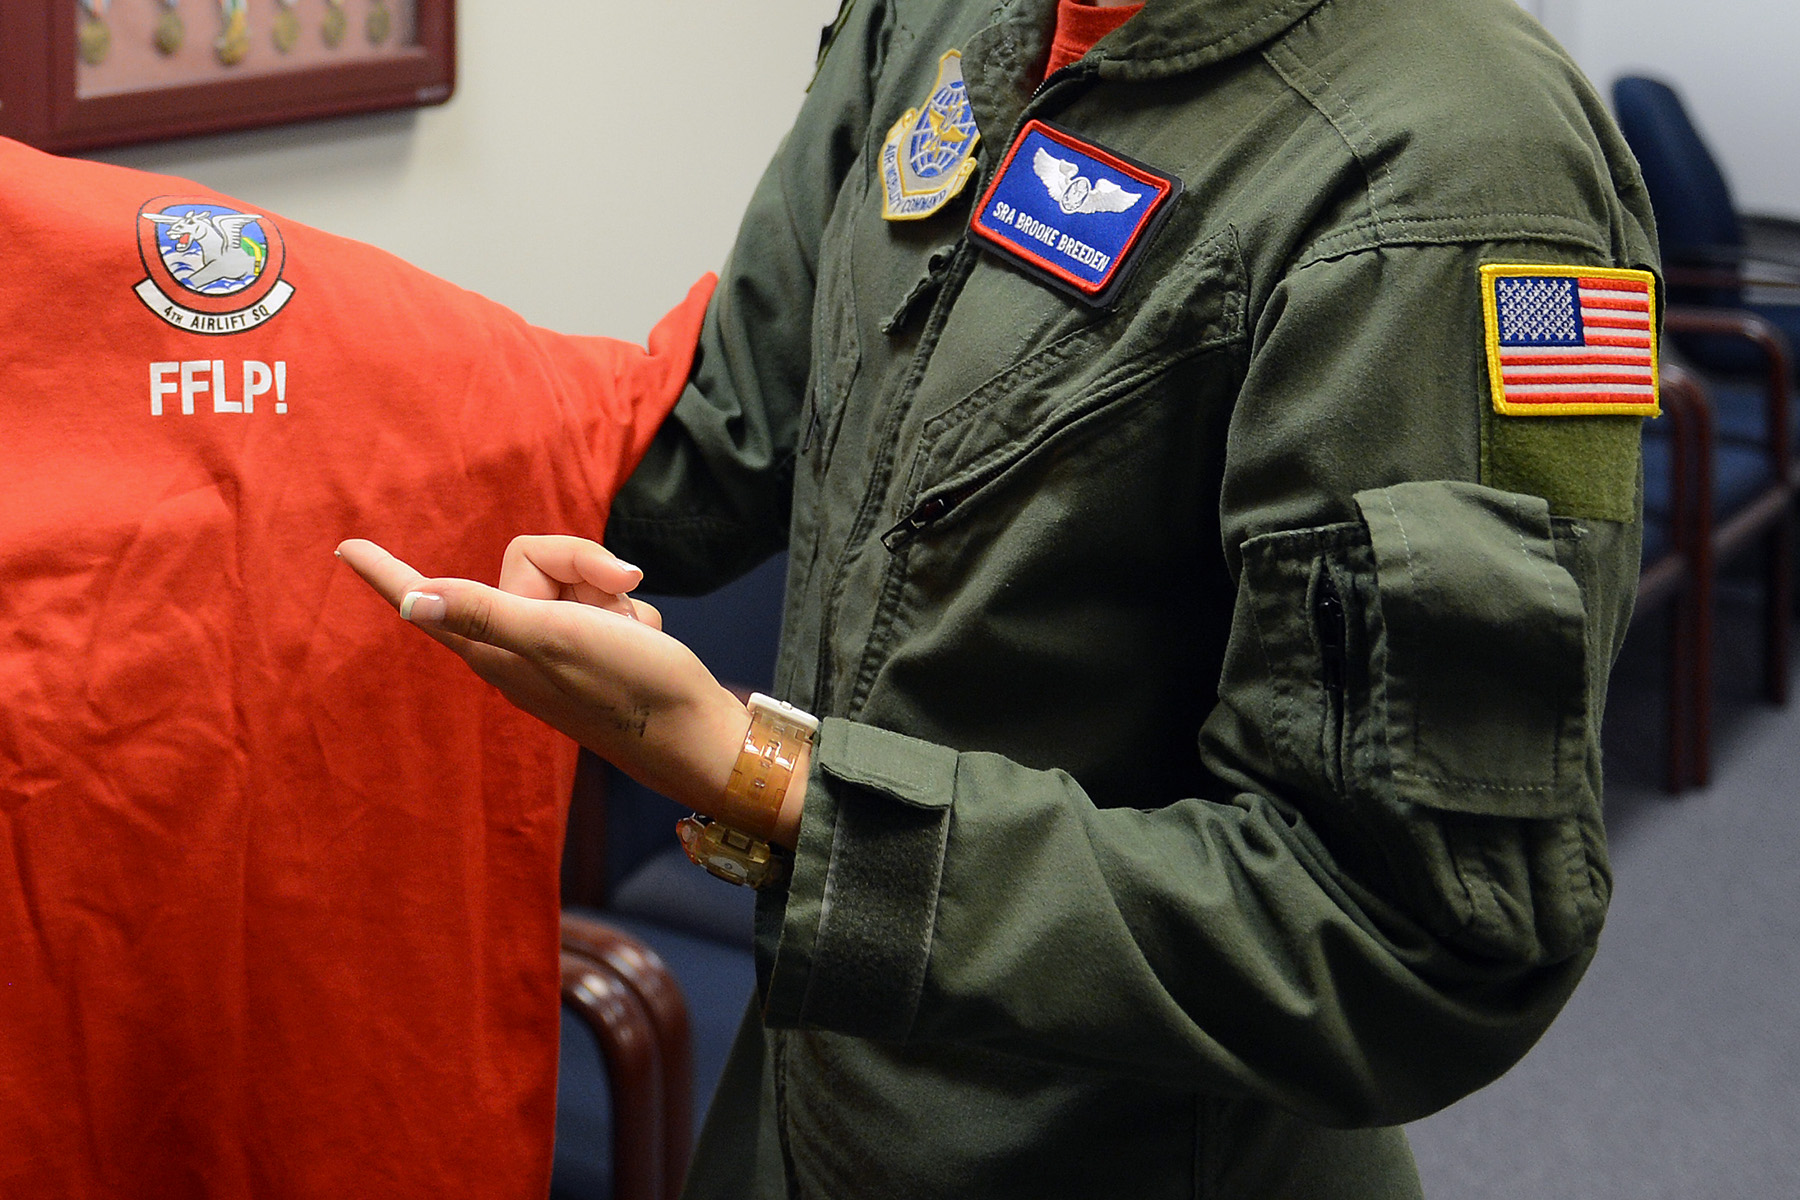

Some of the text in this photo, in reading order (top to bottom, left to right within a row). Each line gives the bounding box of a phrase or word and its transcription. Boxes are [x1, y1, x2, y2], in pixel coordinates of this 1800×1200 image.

[992, 201, 1111, 272] SRA BROOKE BREEDEN
[163, 304, 271, 331] 4TH AIRLIFT SQ
[149, 359, 288, 416] FFLP!
